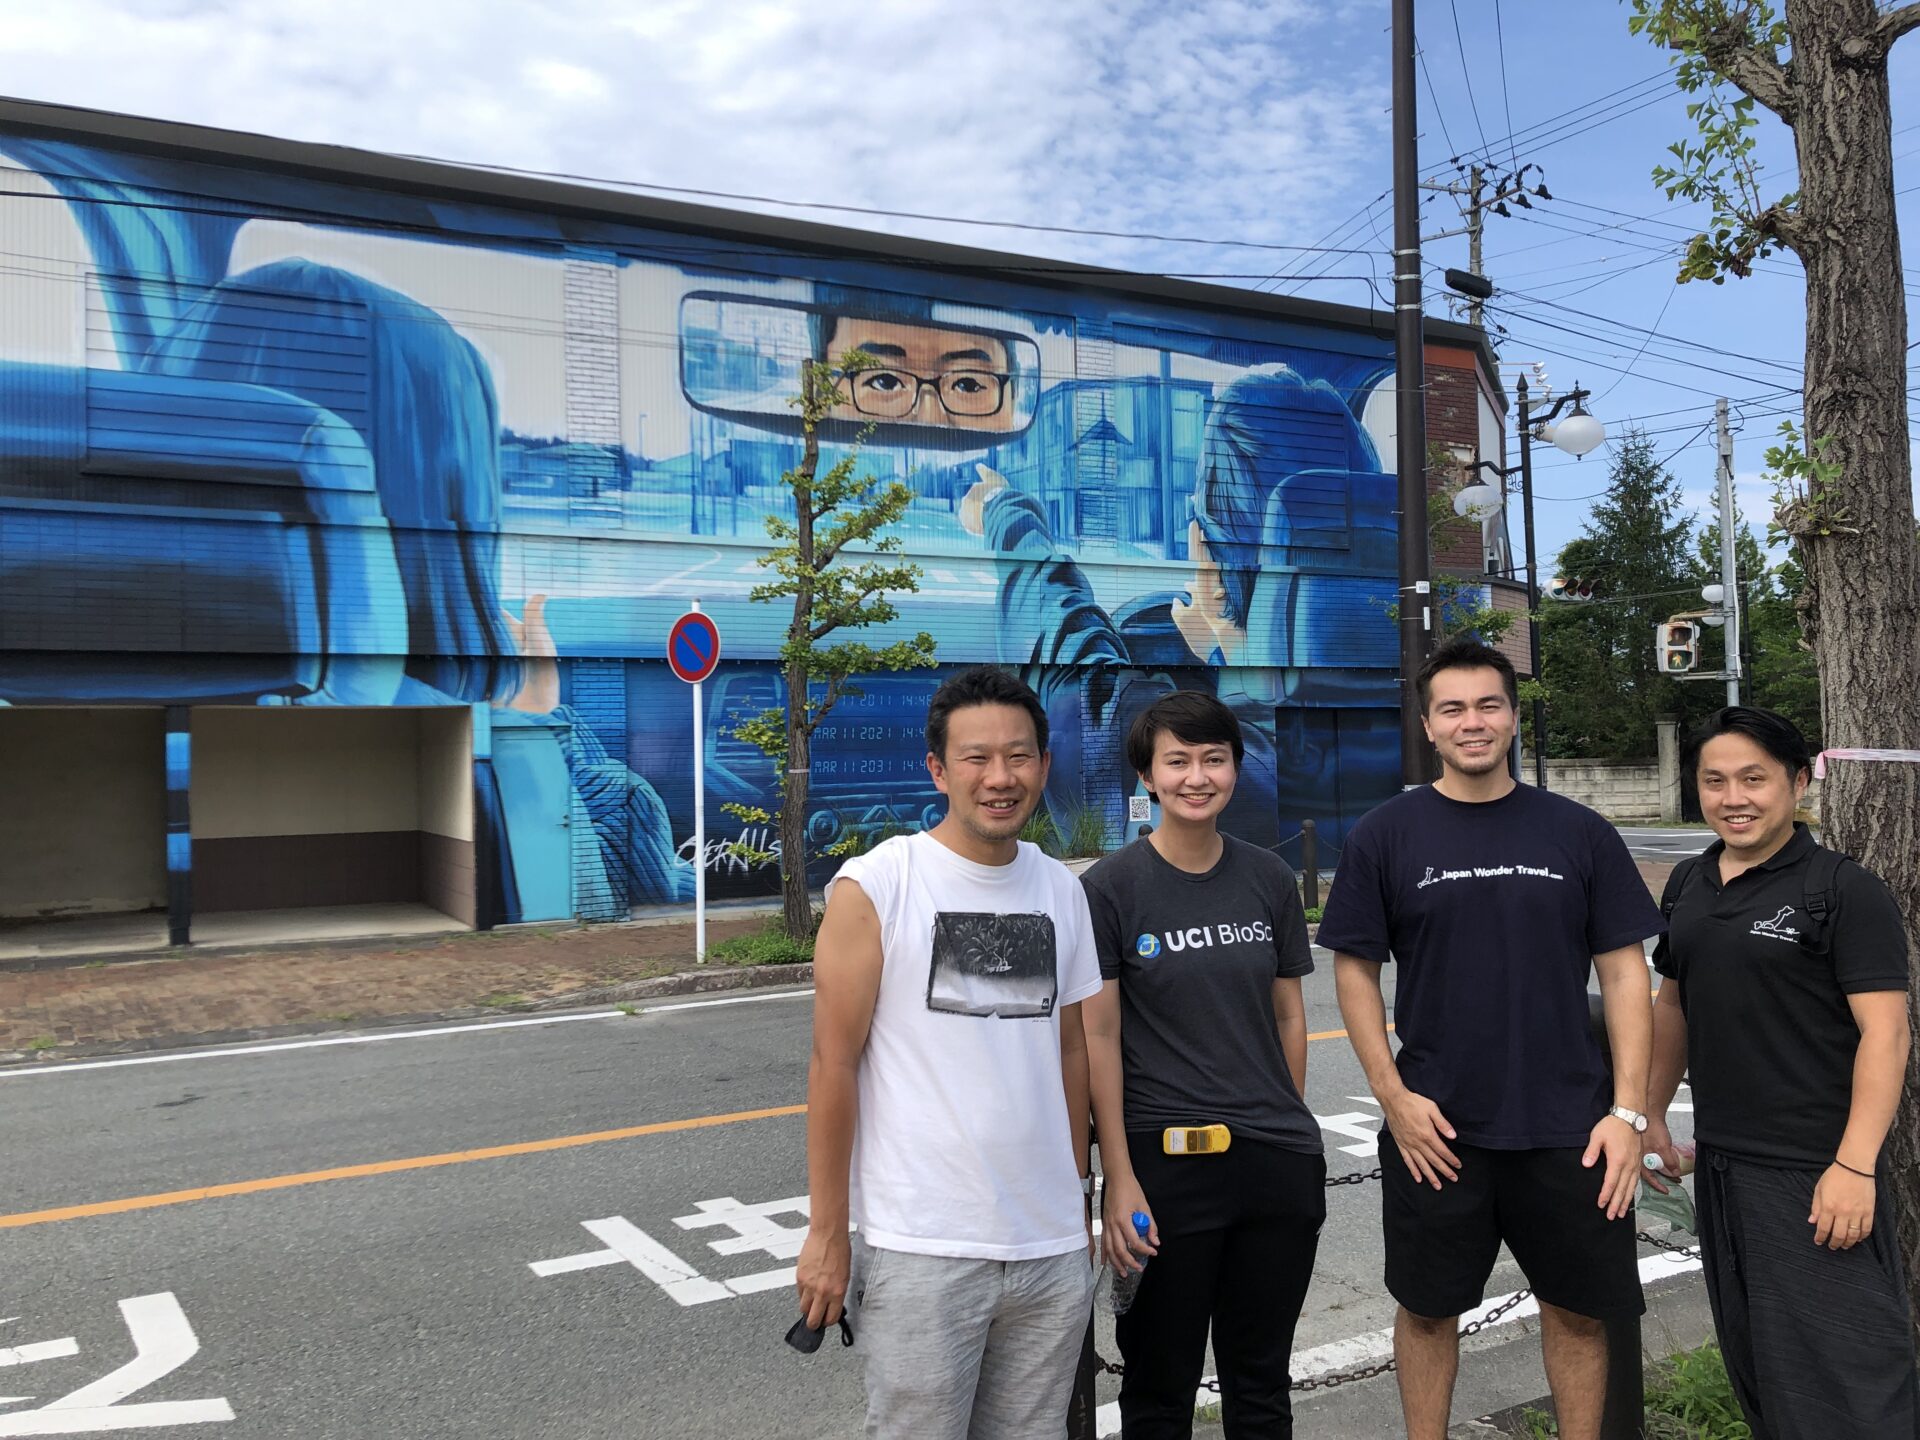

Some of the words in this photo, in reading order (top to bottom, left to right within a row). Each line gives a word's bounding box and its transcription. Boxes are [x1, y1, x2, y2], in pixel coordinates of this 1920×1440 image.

[860, 694, 891, 706] 2011
[814, 727, 837, 739] MAR
[843, 727, 855, 739] 11
[860, 727, 891, 739] 2021
[902, 727, 926, 738] 14:4
[814, 761, 837, 773] MAR
[843, 761, 855, 772] 11
[860, 760, 891, 772] 2031
[903, 760, 926, 772] 14:4
[1441, 870, 1472, 881] Japan
[1474, 865, 1514, 877] Wonder
[1164, 926, 1214, 952] UCI
